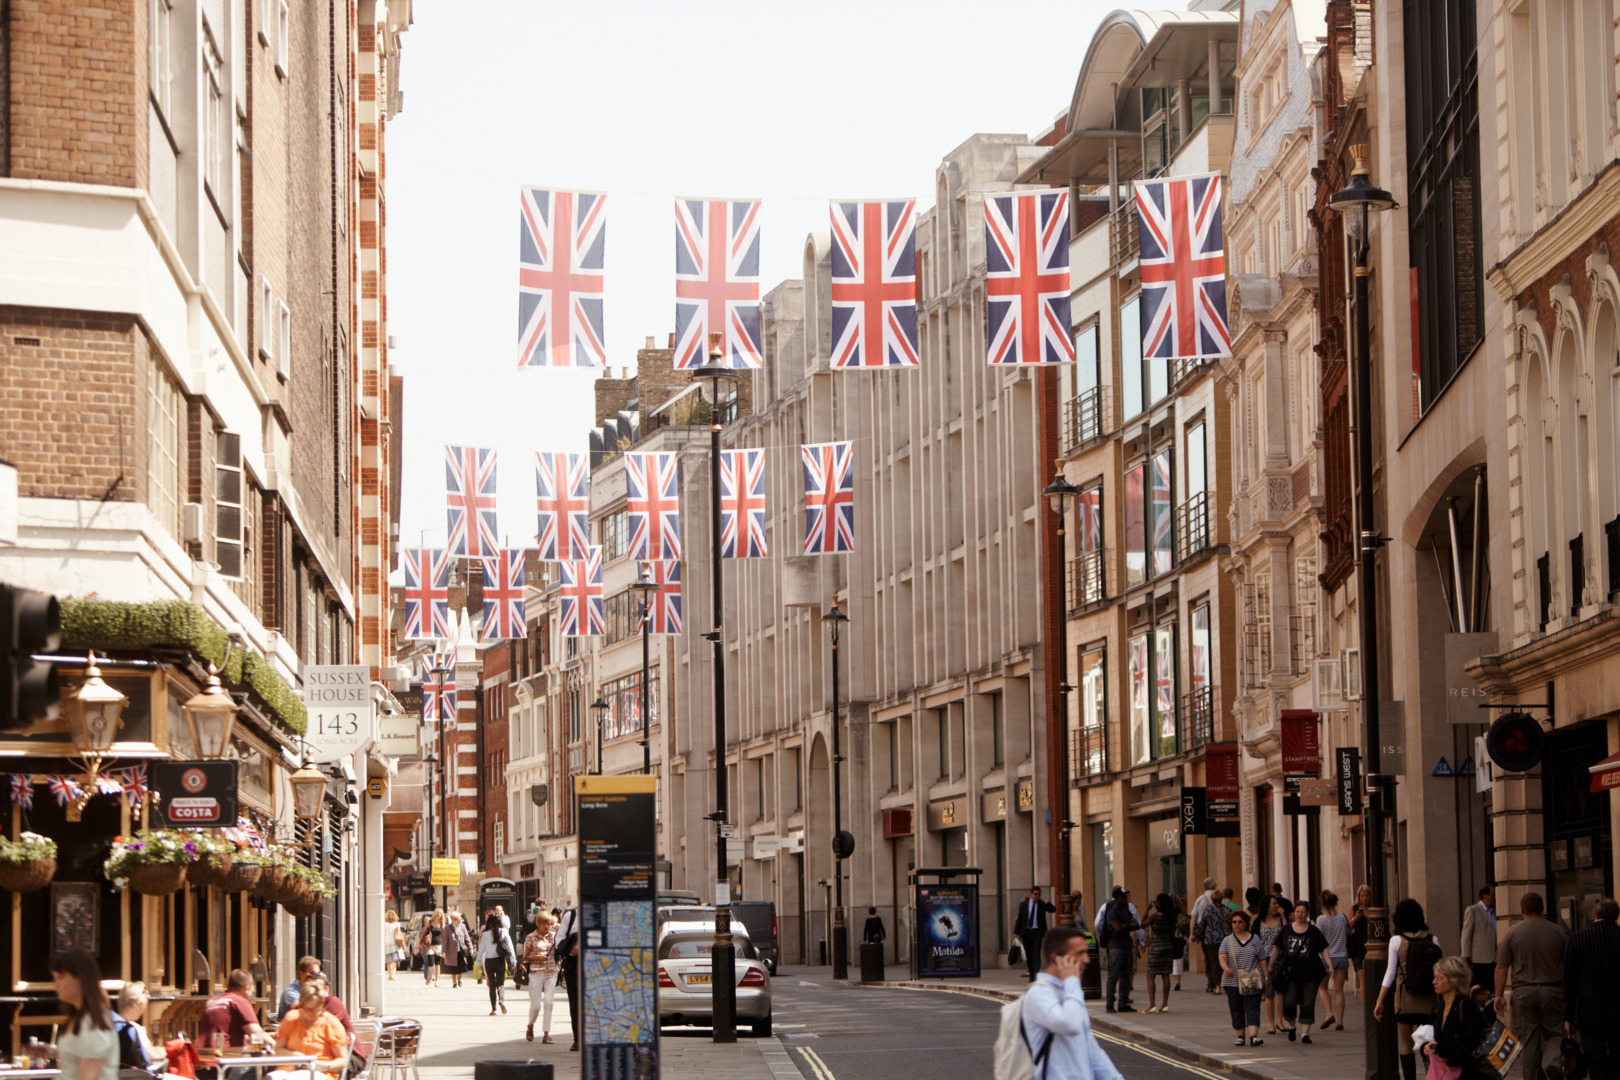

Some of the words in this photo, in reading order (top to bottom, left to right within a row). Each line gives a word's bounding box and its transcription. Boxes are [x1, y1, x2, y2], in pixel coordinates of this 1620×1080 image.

[309, 672, 365, 685] SUSSEX
[310, 688, 365, 701] HOUSE
[317, 712, 358, 735] 143
[1342, 751, 1351, 779] WEST
[1343, 780, 1353, 812] JEANS
[175, 807, 213, 818] COSTA
[1183, 795, 1195, 832] next
[932, 945, 965, 958] Matilda
